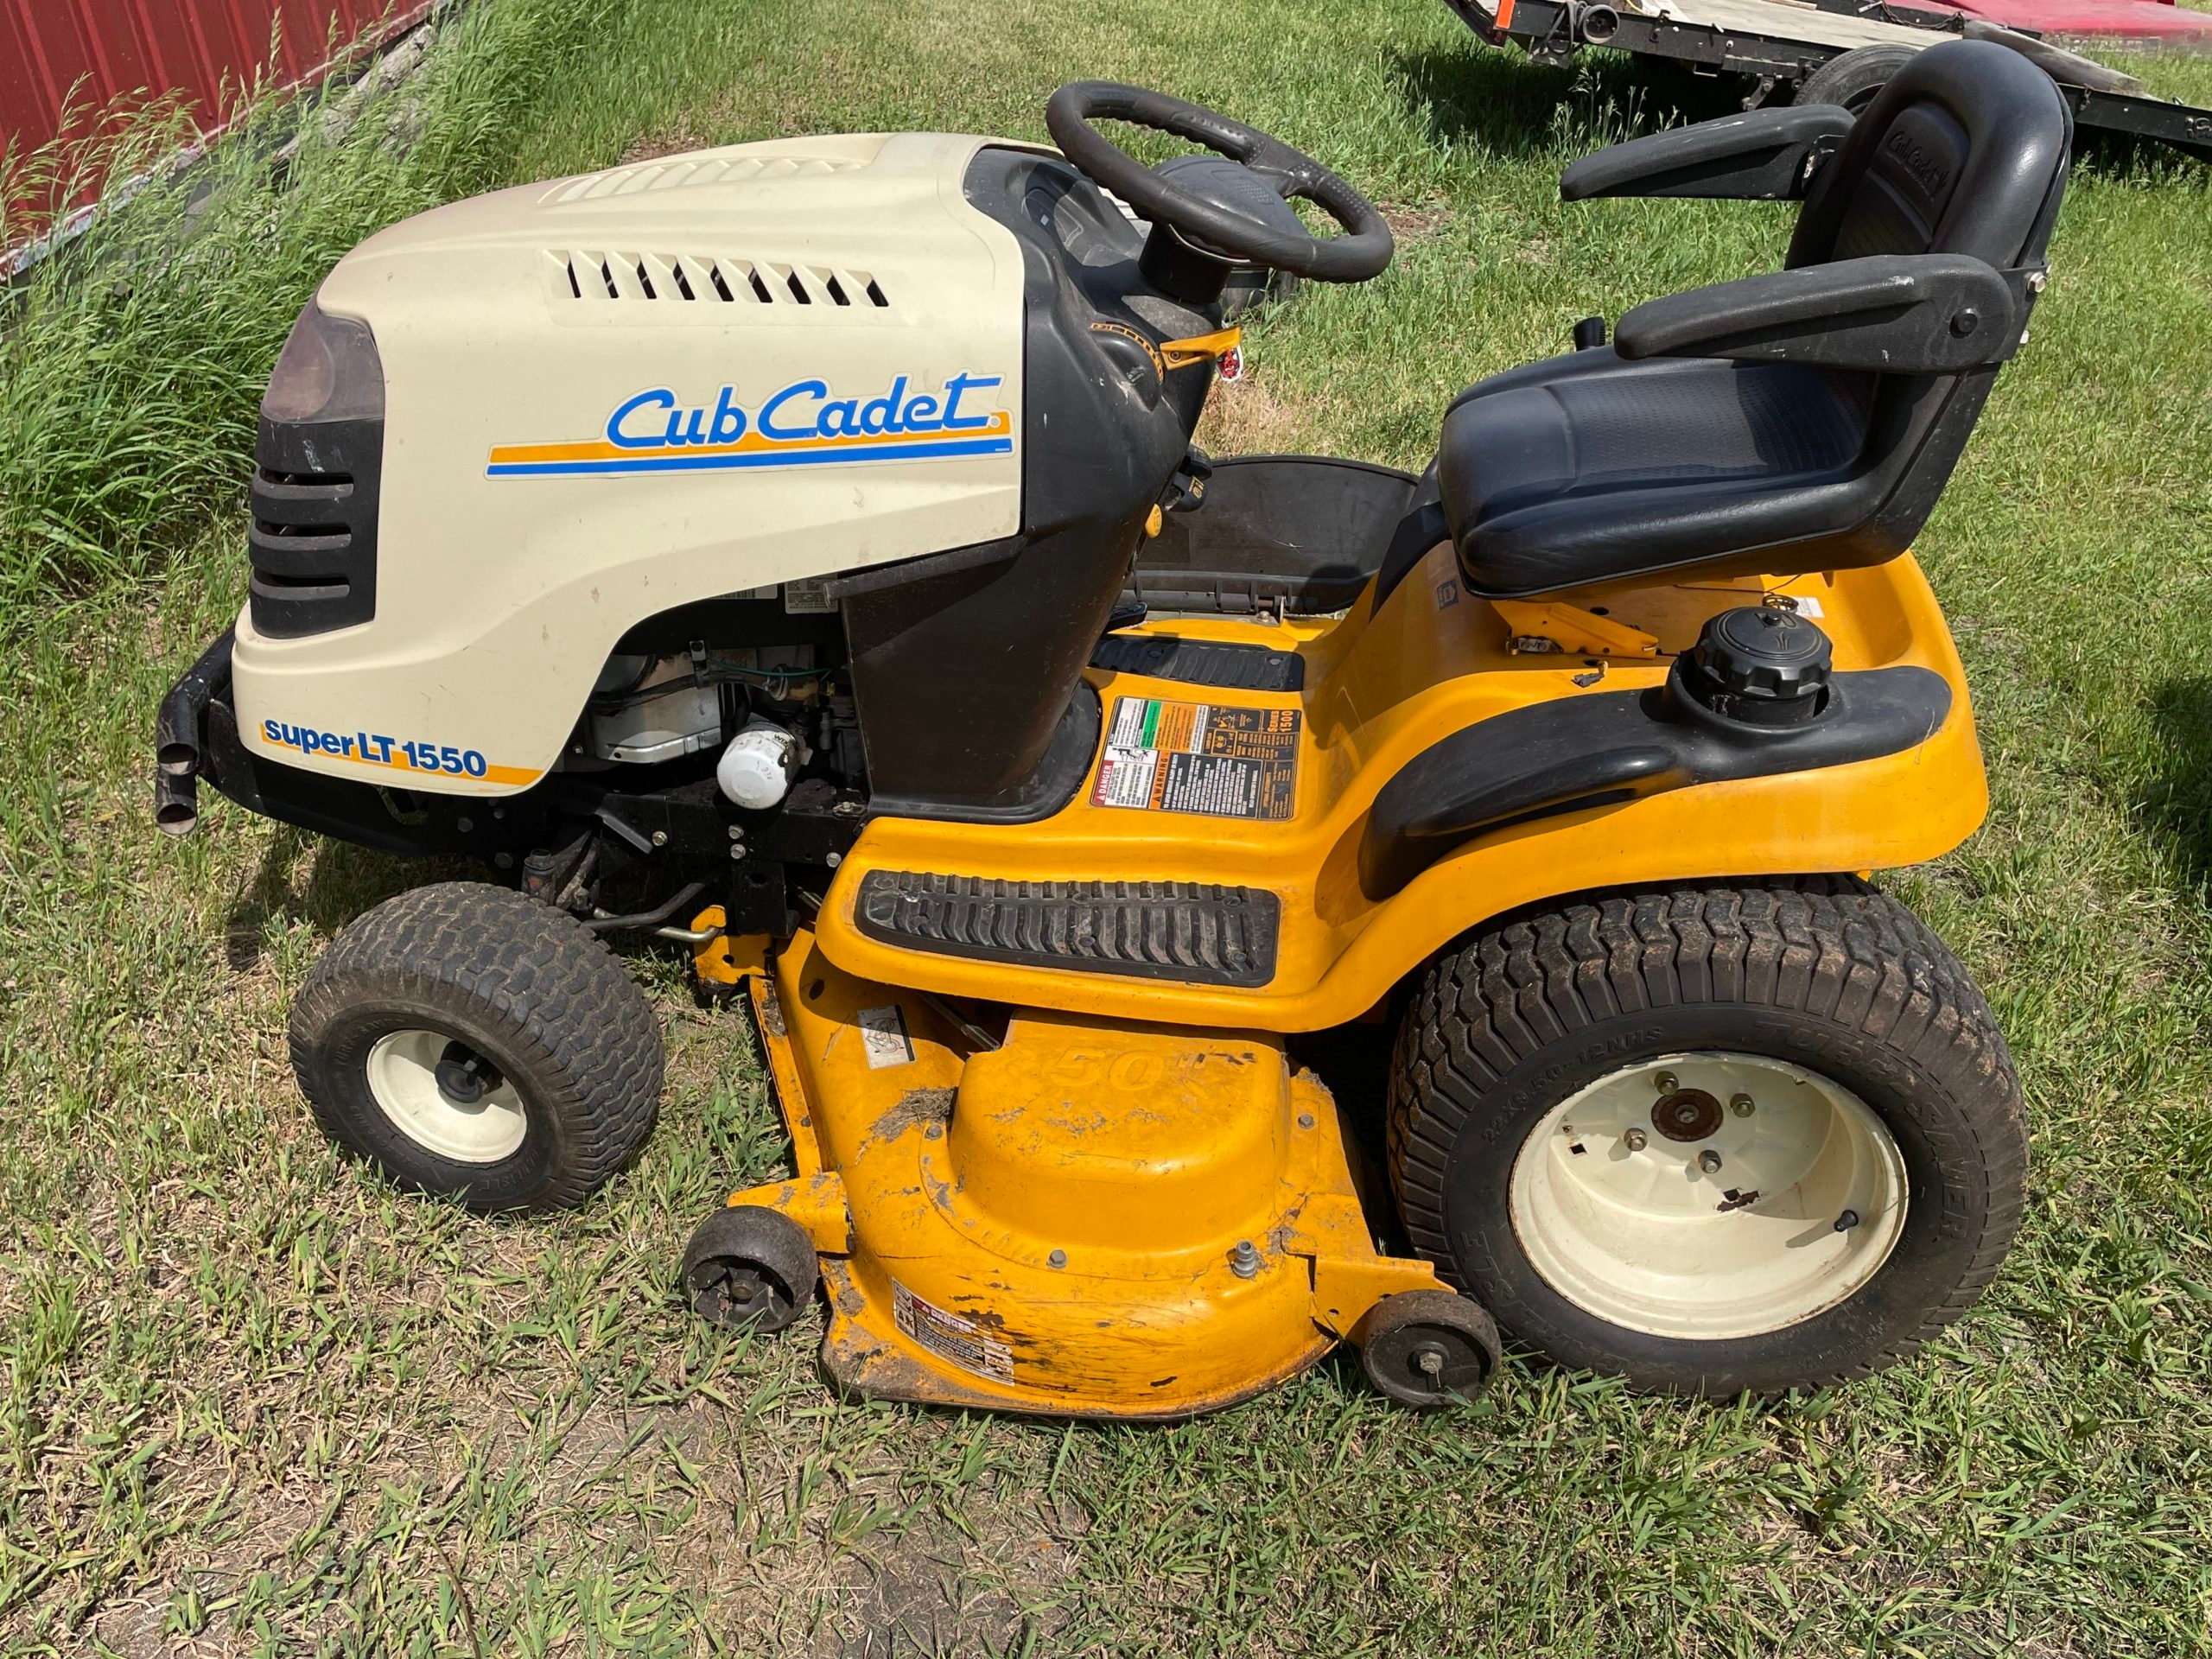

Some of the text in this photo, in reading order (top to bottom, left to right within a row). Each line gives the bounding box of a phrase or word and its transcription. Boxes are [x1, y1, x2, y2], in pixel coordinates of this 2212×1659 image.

[606, 372, 1001, 449] Cub Cadet
[1280, 710, 1294, 733] 1500
[264, 719, 355, 754] super
[402, 741, 487, 777] 1550
[1098, 765, 1113, 793] DANGER
[1154, 758, 1168, 795] WARNING
